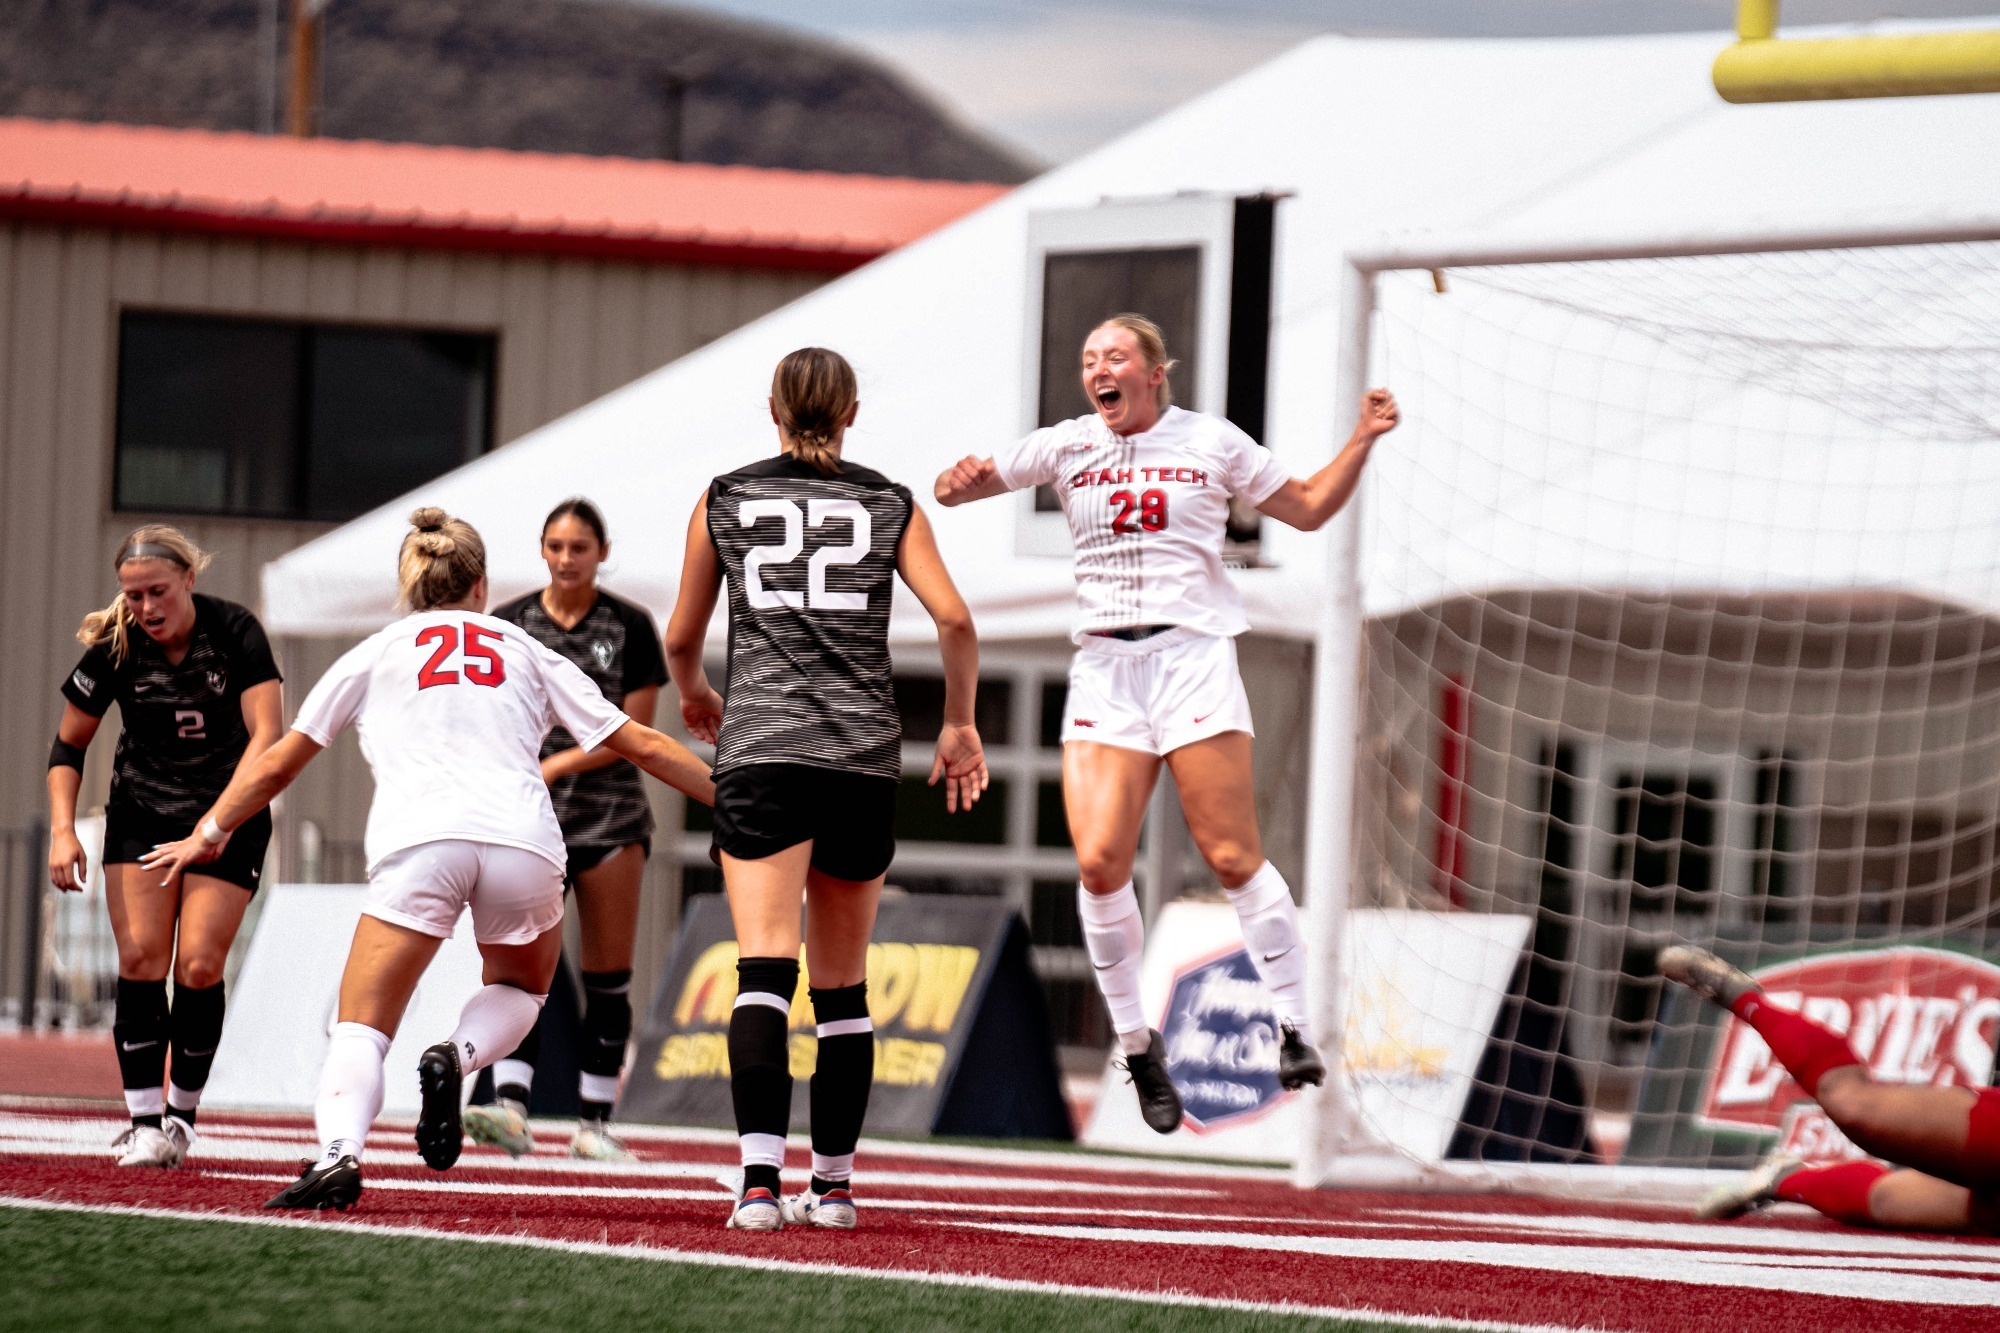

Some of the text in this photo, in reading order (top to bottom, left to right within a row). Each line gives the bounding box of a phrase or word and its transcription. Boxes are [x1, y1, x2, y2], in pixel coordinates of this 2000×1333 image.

[1073, 466, 1208, 488] UTAH TECH
[1109, 488, 1169, 534] 28
[738, 498, 872, 610] 22
[415, 621, 507, 691] 25
[175, 710, 206, 739] 2
